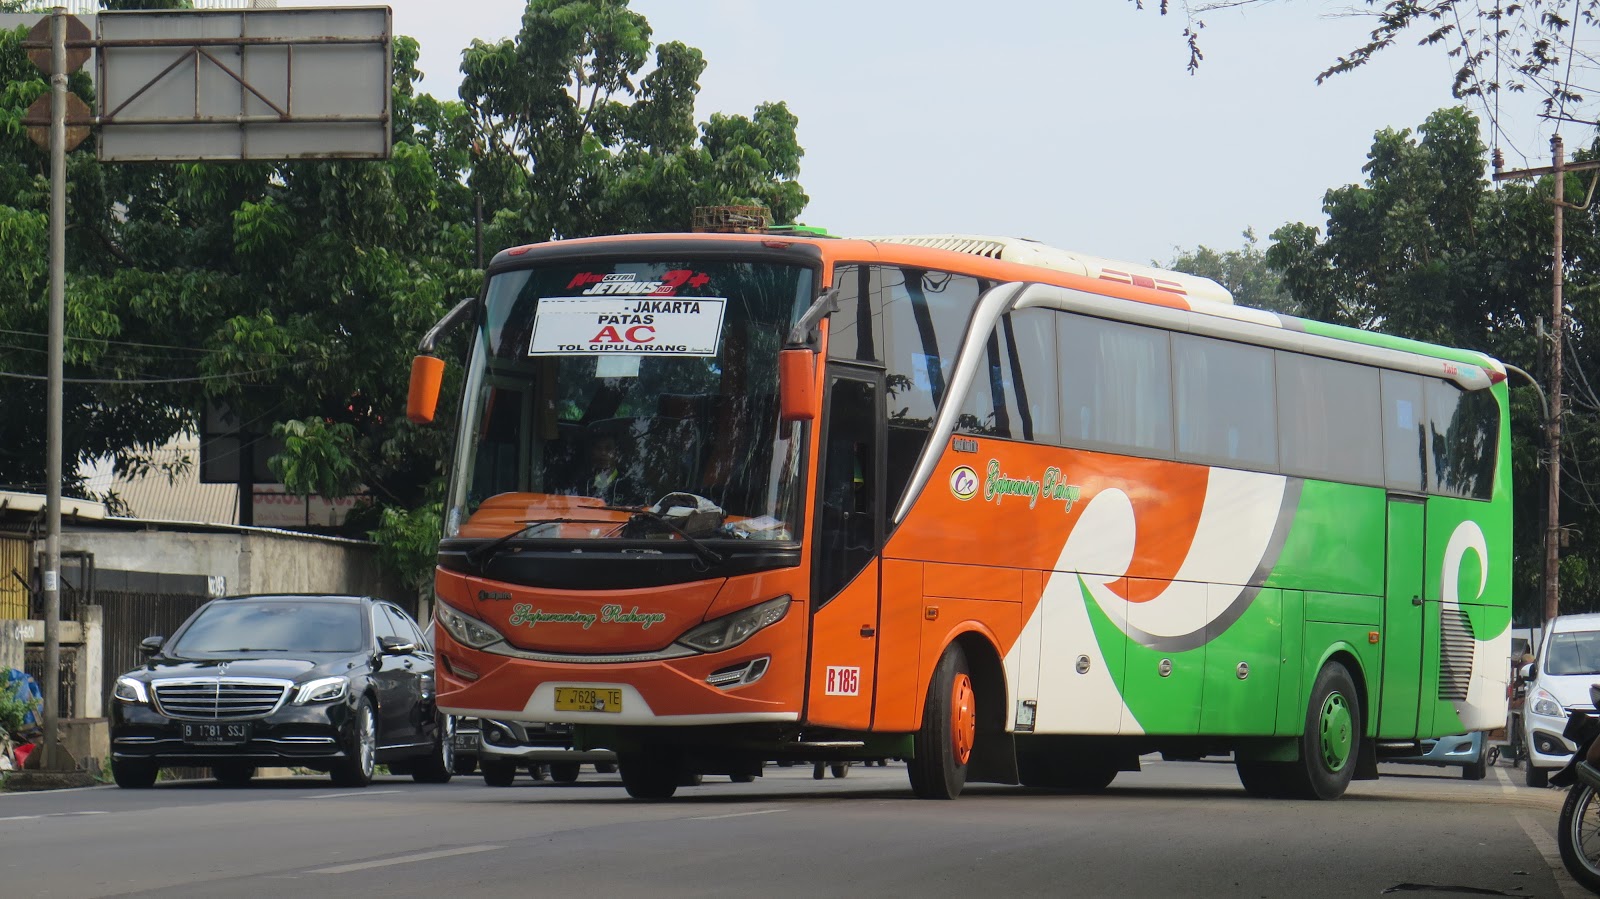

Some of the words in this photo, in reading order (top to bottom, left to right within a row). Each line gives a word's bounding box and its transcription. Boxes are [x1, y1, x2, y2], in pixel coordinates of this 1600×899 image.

[583, 282, 662, 294] JETBUS
[633, 301, 700, 313] JAKARTA
[598, 315, 654, 324] PATAS
[589, 326, 656, 343] AC
[828, 669, 835, 692] R
[838, 669, 857, 693] 185
[556, 690, 562, 703] Z
[573, 690, 596, 704] 7628
[608, 691, 619, 704] TE
[185, 725, 192, 736] B
[228, 725, 244, 736] SSJ
